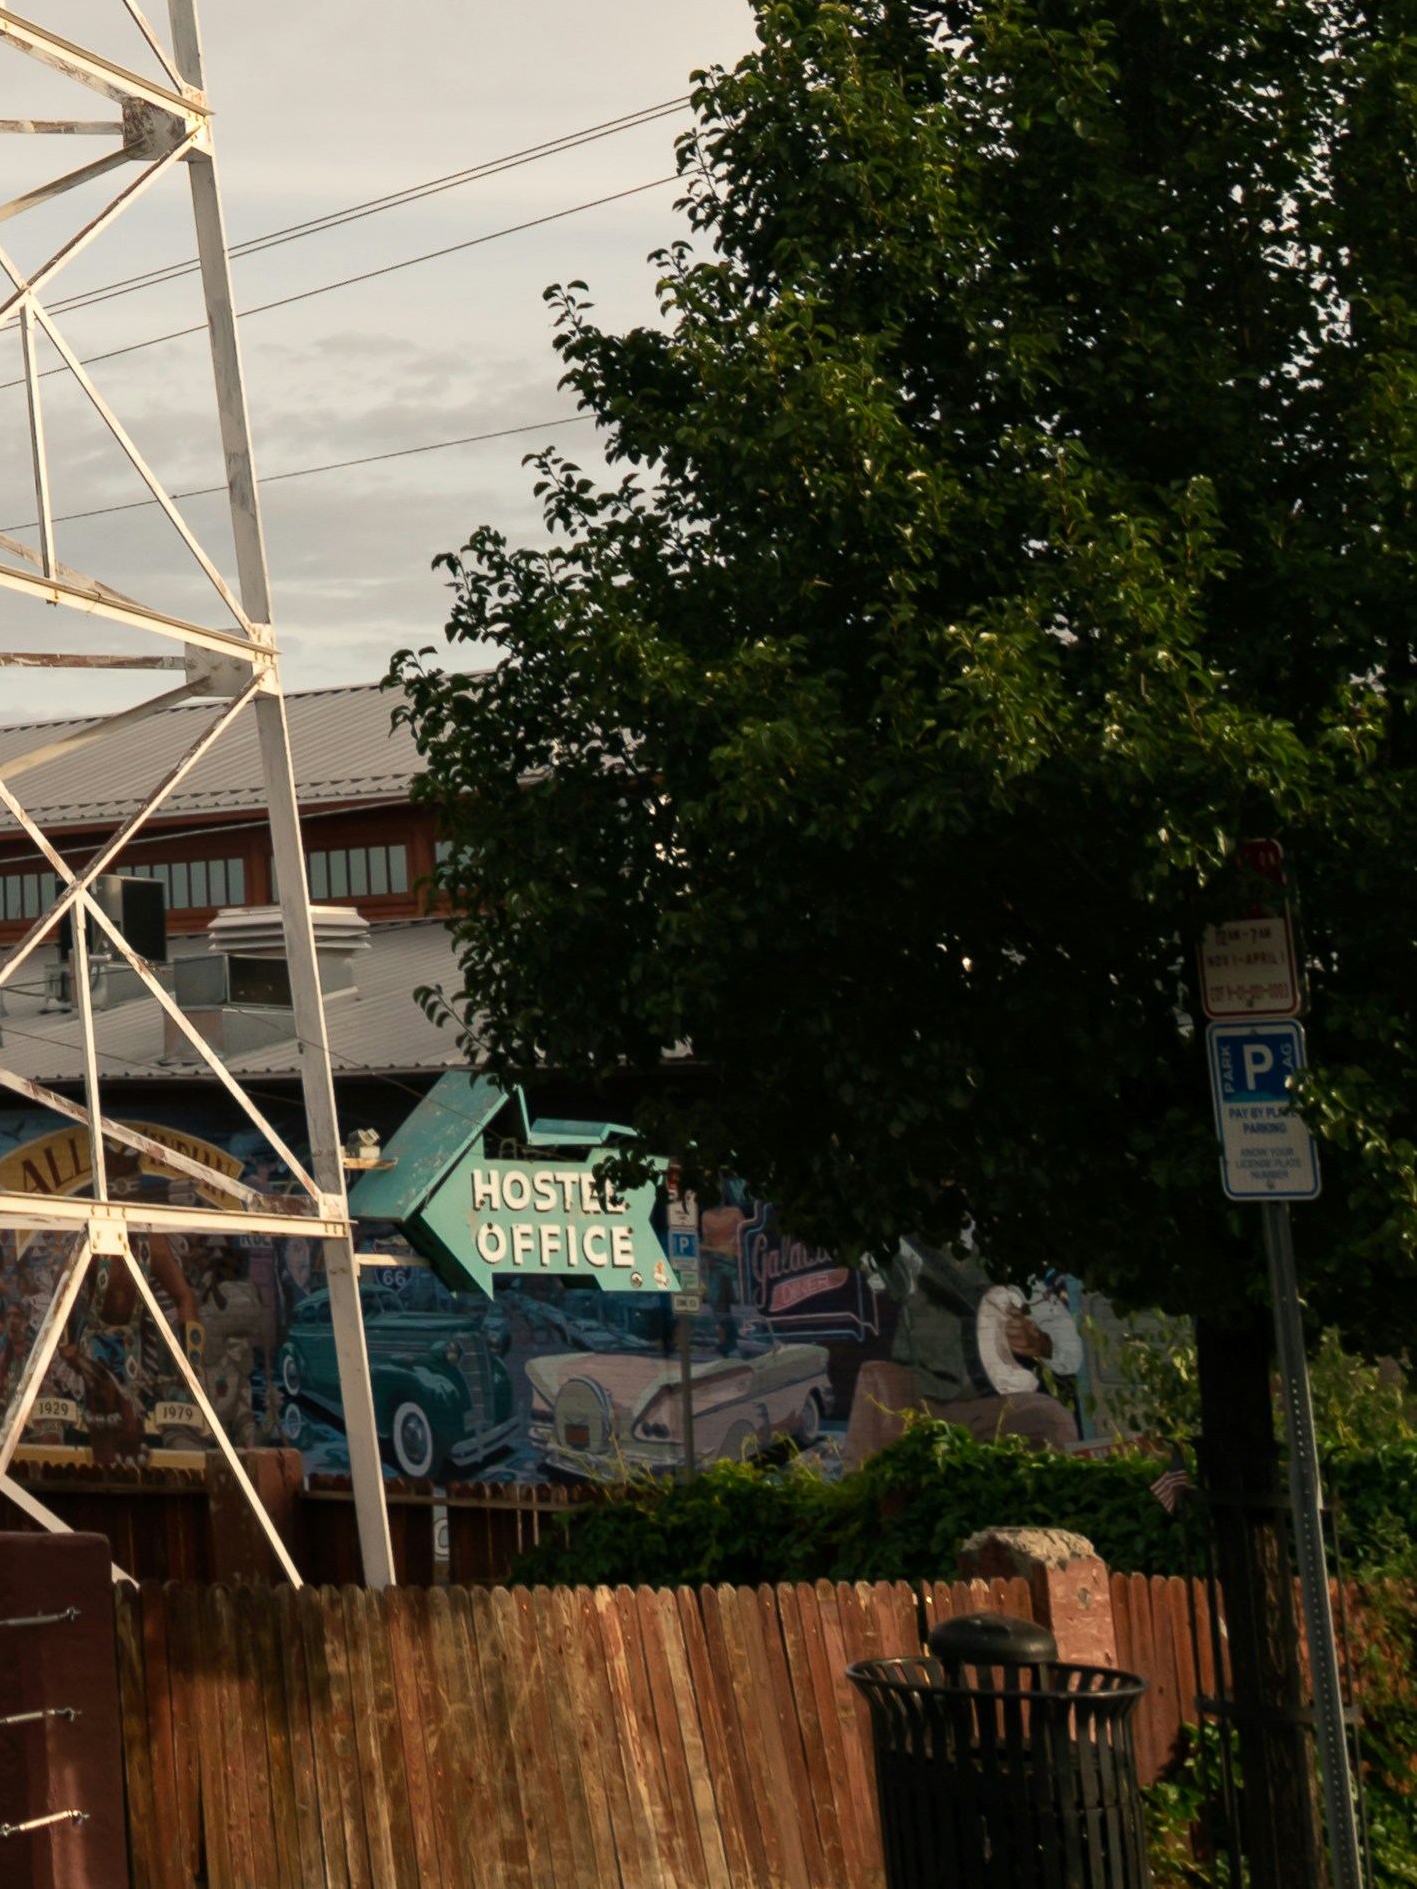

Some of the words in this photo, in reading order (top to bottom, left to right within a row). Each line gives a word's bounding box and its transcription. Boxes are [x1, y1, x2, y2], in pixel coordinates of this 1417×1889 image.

[1220, 1045, 1235, 1093] PARK
[1243, 1043, 1274, 1091] P
[1229, 1108, 1248, 1119] PAY
[1250, 1107, 1263, 1119] BY
[1243, 1122, 1287, 1134] PARKING
[20, 1138, 93, 1195] ALL
[475, 1223, 635, 1267] OFFICE
[382, 1270, 407, 1286] 66
[781, 1274, 831, 1303] DINER
[37, 1401, 69, 1417] 1929
[162, 1405, 194, 1421] 1979
